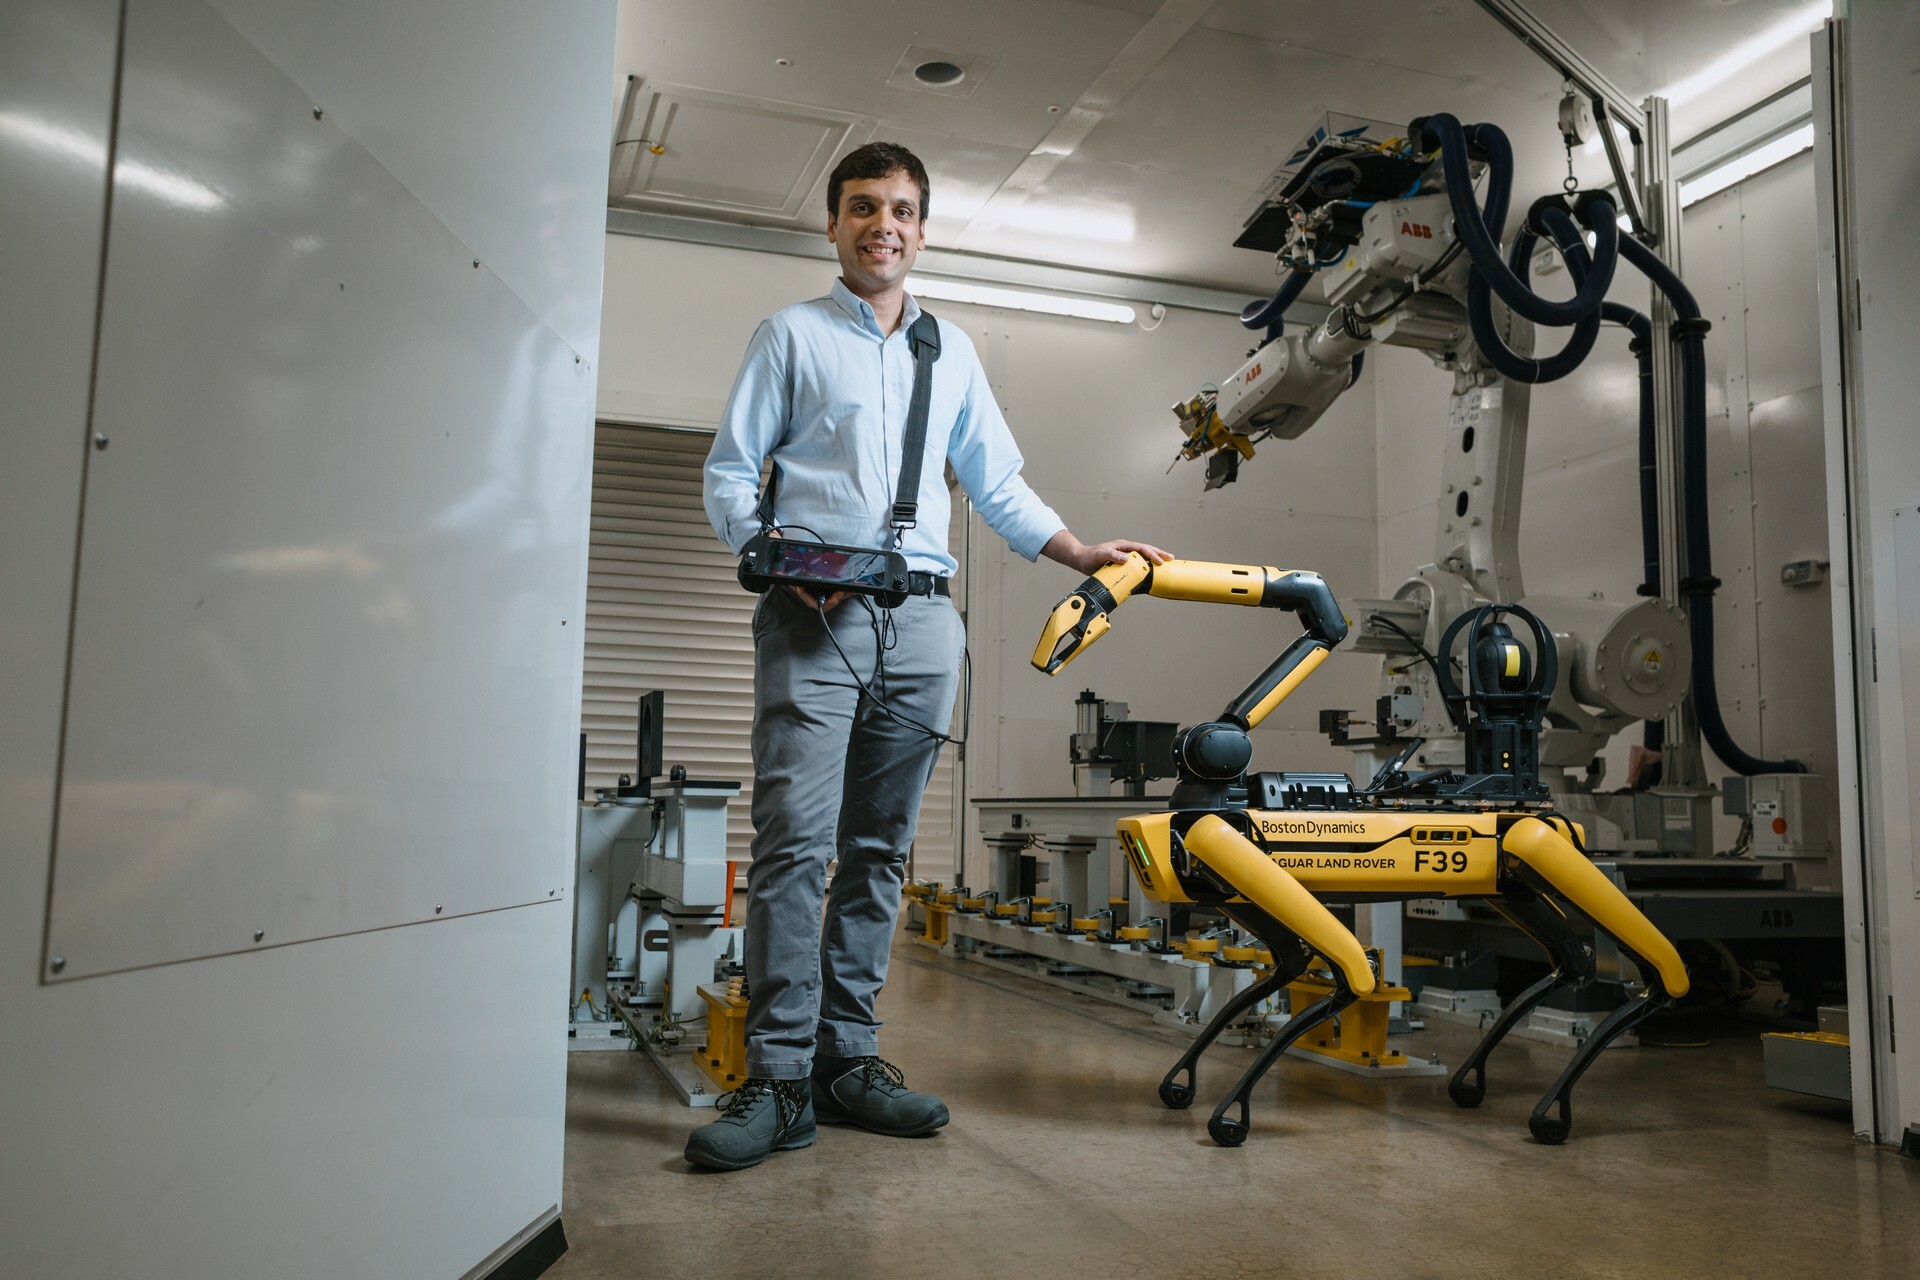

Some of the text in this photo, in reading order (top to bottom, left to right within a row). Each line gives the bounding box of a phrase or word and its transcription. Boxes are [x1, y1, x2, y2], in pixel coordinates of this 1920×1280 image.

[1401, 221, 1433, 240] ABB
[1245, 362, 1262, 386] ABB
[1271, 858, 1396, 868] GUAR LAND ROVER
[1414, 850, 1468, 873] F39
[1760, 910, 1793, 928] ABB
